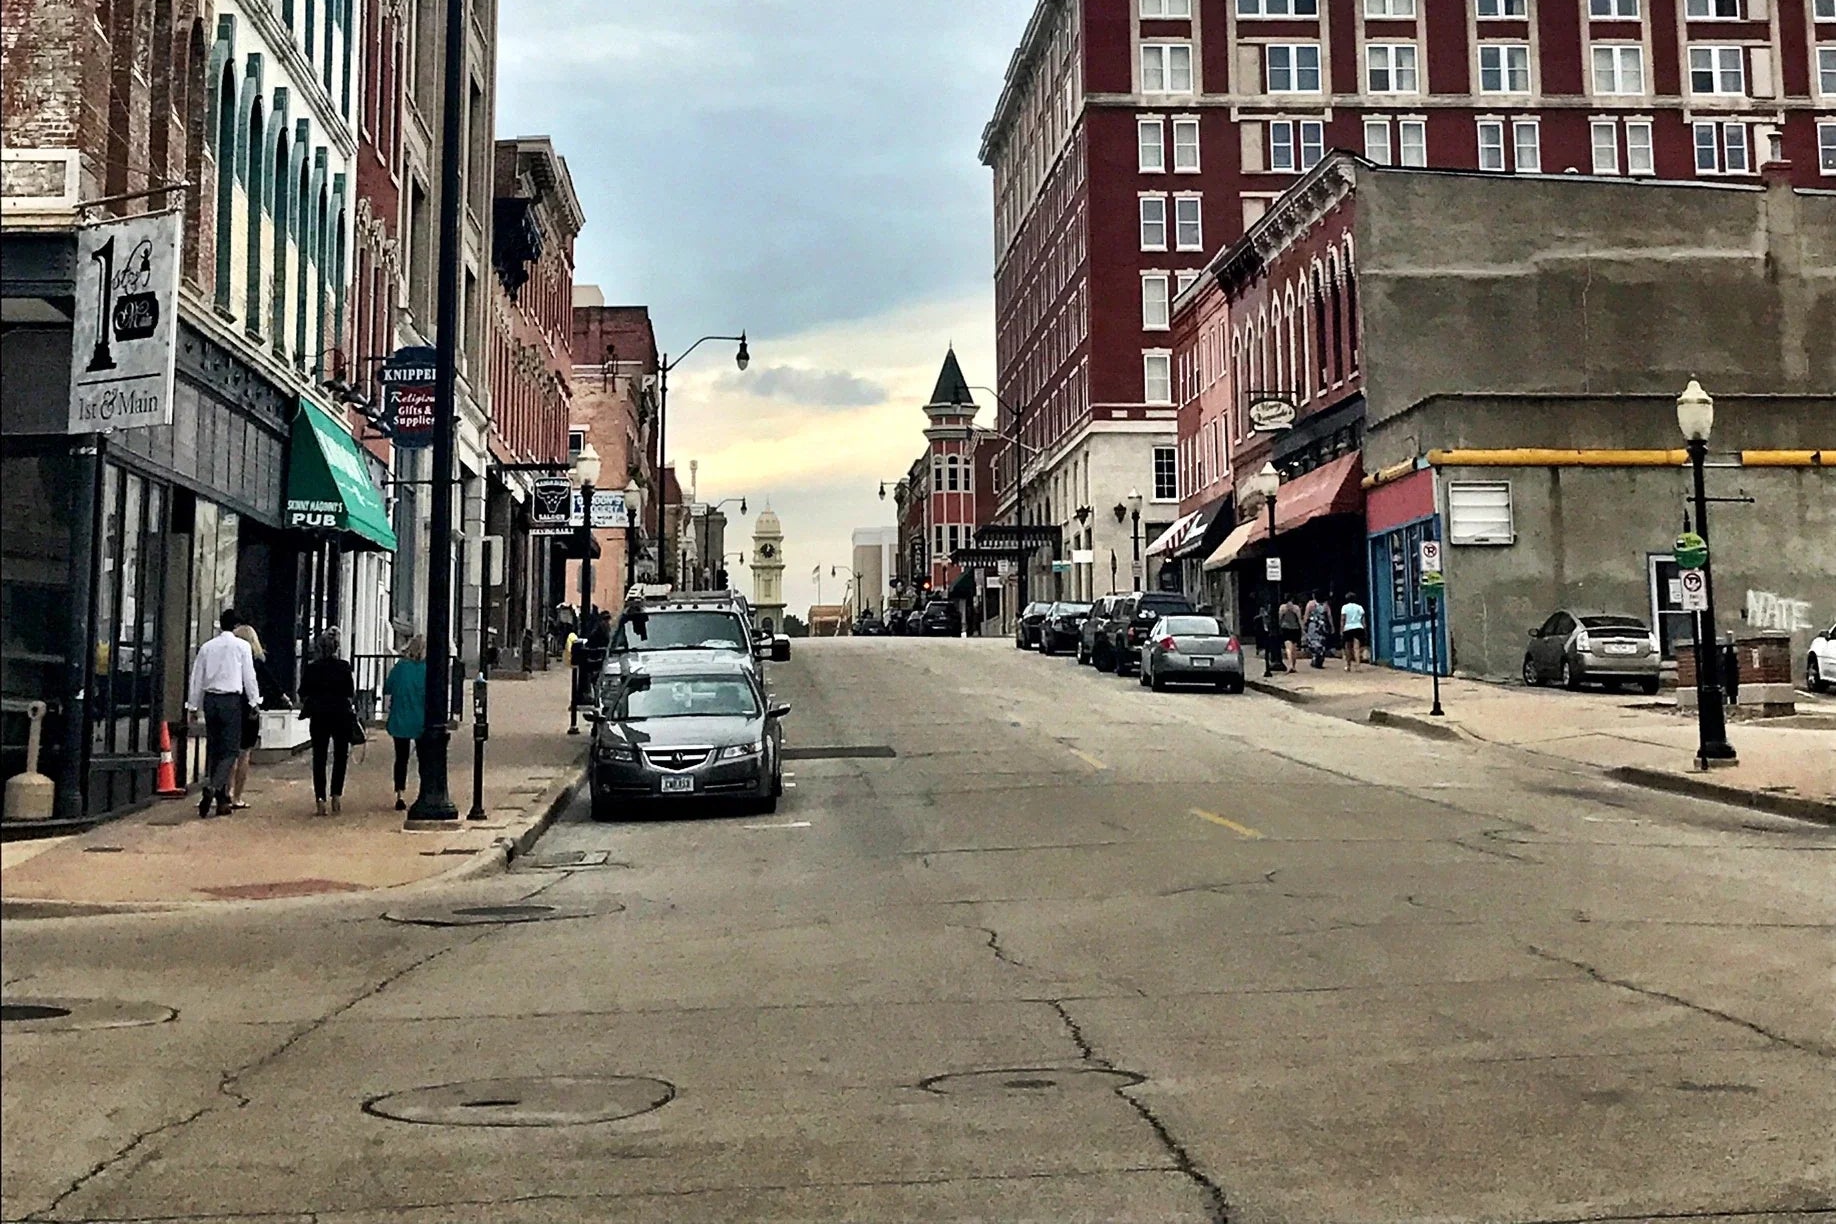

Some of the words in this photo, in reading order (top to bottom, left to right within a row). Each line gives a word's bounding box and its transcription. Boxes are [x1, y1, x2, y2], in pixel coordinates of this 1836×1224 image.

[79, 397, 97, 421] 1st
[100, 387, 118, 421] &
[118, 389, 158, 416] Main
[390, 391, 436, 405] Religiou
[398, 405, 423, 415] Gifts
[424, 405, 432, 415] &
[291, 512, 337, 527] PUB
[1746, 588, 1816, 632] NATE
